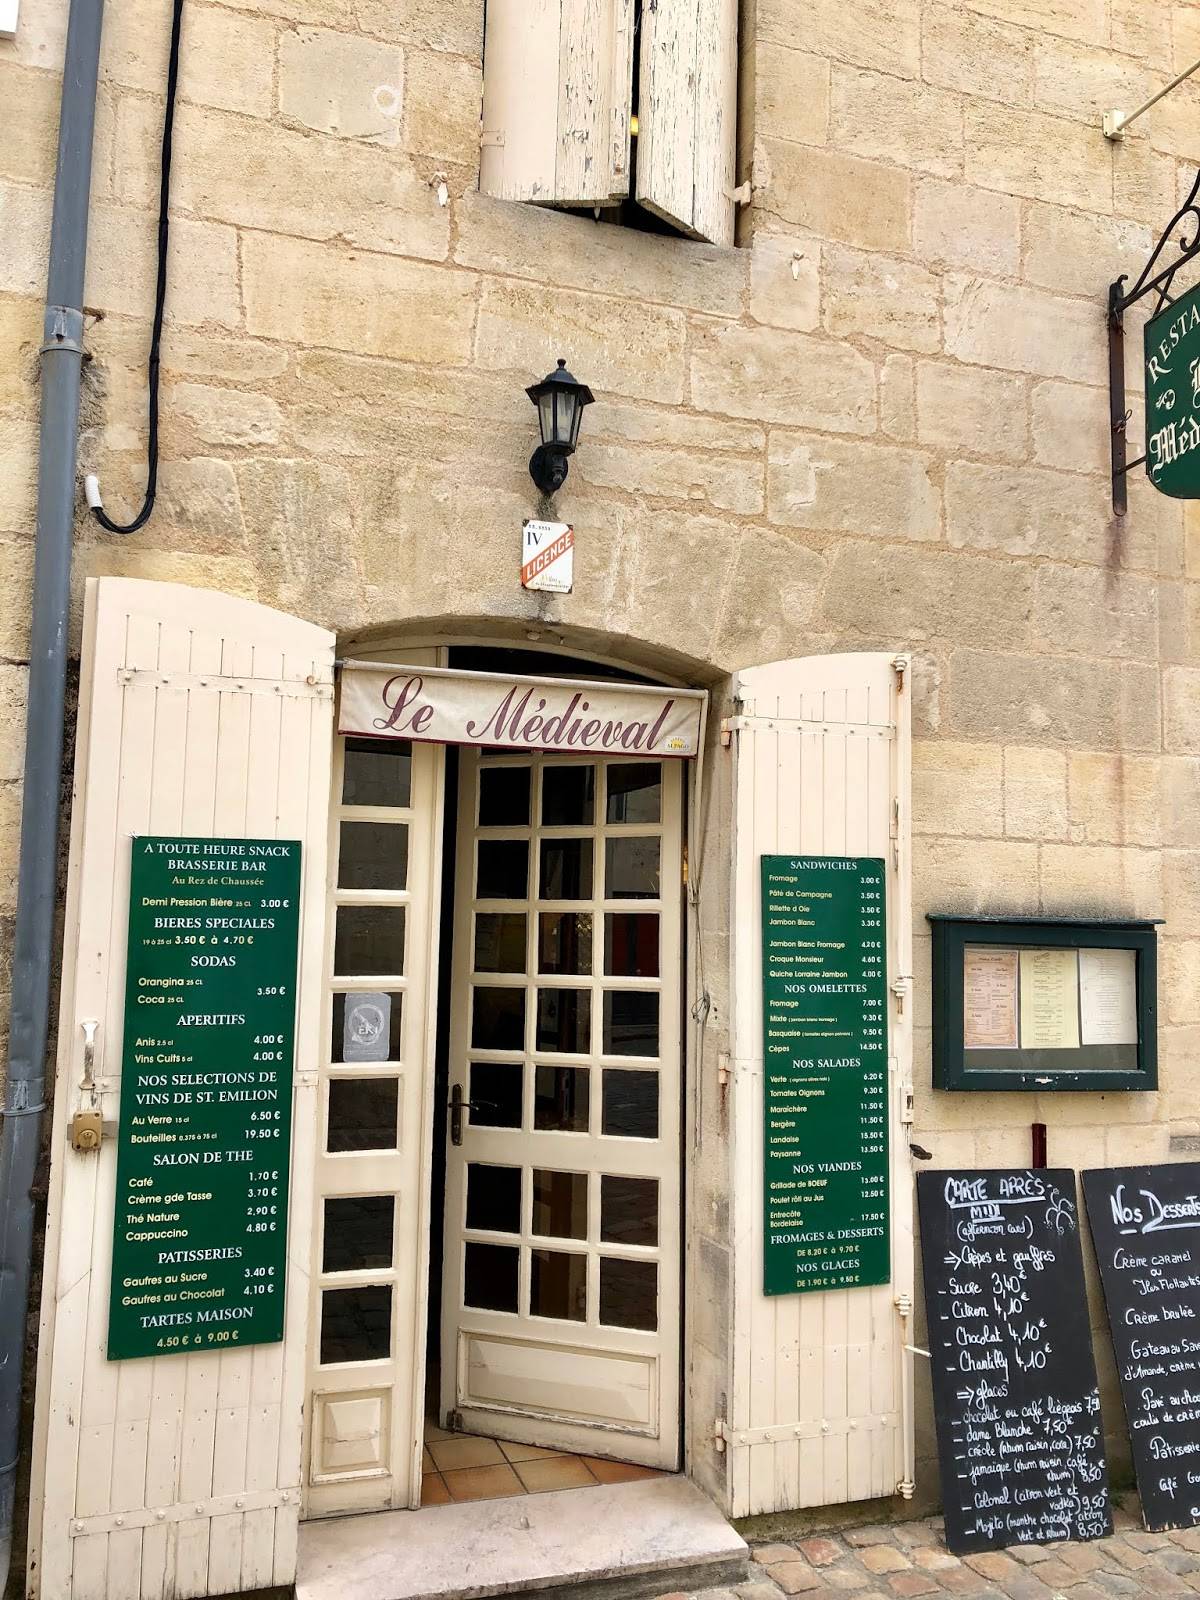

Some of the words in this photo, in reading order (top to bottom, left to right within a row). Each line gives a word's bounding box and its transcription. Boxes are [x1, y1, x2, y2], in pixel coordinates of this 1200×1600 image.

[1149, 304, 1200, 384] RESTA
[527, 532, 542, 545] IV
[527, 533, 571, 579] LICENCE
[372, 675, 434, 733] Le
[466, 686, 675, 751] Médieval
[145, 844, 153, 853] A
[157, 844, 200, 854] TOUTE
[204, 846, 245, 855] HEURE
[249, 846, 290, 856] SNACK
[168, 860, 238, 870] BRASSERIE
[242, 862, 267, 871] BAR
[791, 861, 857, 870] SANDWICHES
[208, 877, 218, 885] de
[221, 877, 264, 885] Chaussée
[211, 898, 232, 906] Bière
[155, 918, 201, 928] BIERES
[206, 919, 275, 928] SPECIALES
[191, 956, 236, 966] SODAS
[139, 978, 184, 988] Orangina
[809, 984, 867, 992] OMELETTES
[177, 1015, 245, 1025] APERITIFS
[136, 1038, 155, 1046] Anis
[135, 1055, 153, 1063] Vins
[157, 1054, 180, 1062] Cuits
[793, 1060, 813, 1068] NOS
[818, 1059, 861, 1067] SALADES
[138, 1075, 167, 1086] NOS
[172, 1072, 254, 1085] SELECTIONS
[259, 1072, 277, 1082] DE
[136, 1093, 169, 1104] VINS
[173, 1092, 192, 1103] DE
[196, 1092, 214, 1102] ST.
[219, 1090, 278, 1102] EMILION
[132, 1117, 144, 1125] Au
[148, 1116, 172, 1124] Verre
[771, 1120, 795, 1128] Bergère
[131, 1134, 176, 1143] Bouteilles
[153, 1153, 200, 1165] SALON
[204, 1152, 222, 1163] DE
[226, 1151, 253, 1162] THE
[793, 1164, 814, 1174] NOS
[818, 1162, 862, 1172] VIANDES
[129, 1178, 153, 1187] Café
[944, 1177, 987, 1203] CARTE
[128, 1194, 161, 1204] Crème
[165, 1194, 184, 1204] gde
[187, 1192, 212, 1200] Tasse
[770, 1196, 789, 1204] Poulet
[1111, 1185, 1143, 1224] Nos
[127, 1215, 144, 1223] Thé
[147, 1213, 179, 1222] Nature
[971, 1205, 1000, 1218] MIDI
[126, 1230, 188, 1241] Cappuccino
[771, 1232, 824, 1244] FROMAGES
[827, 1231, 835, 1239] &
[838, 1227, 884, 1239] DESSERTS
[158, 1248, 242, 1264] PATISSERIES
[996, 1249, 1006, 1262] et
[1013, 1246, 1055, 1270] gauffres
[1114, 1248, 1148, 1269] Crème
[796, 1263, 817, 1273] NOS
[822, 1259, 859, 1270] GLACES
[123, 1276, 162, 1287] Gaufres
[181, 1273, 207, 1282] Sucre
[950, 1278, 982, 1295] Sucre
[122, 1294, 161, 1305] Gaufres
[180, 1288, 224, 1300] Chocolat
[952, 1301, 989, 1318] Citron
[140, 1313, 192, 1328] TARTES
[197, 1307, 253, 1322] MAISON
[1125, 1308, 1160, 1325] Crème
[956, 1324, 1003, 1344] Chocolat
[1171, 1344, 1180, 1354] au
[960, 1350, 1008, 1383] Chantilly
[977, 1379, 1008, 1410] glaces
[963, 1408, 1001, 1424] chocolat
[1006, 1409, 1018, 1418] ou
[1022, 1399, 1043, 1423] café
[1164, 1411, 1174, 1422] de
[967, 1428, 991, 1441] dame
[995, 1424, 1033, 1438] Blanche
[1159, 1477, 1177, 1499] Café
[975, 1488, 1013, 1508] Colonel
